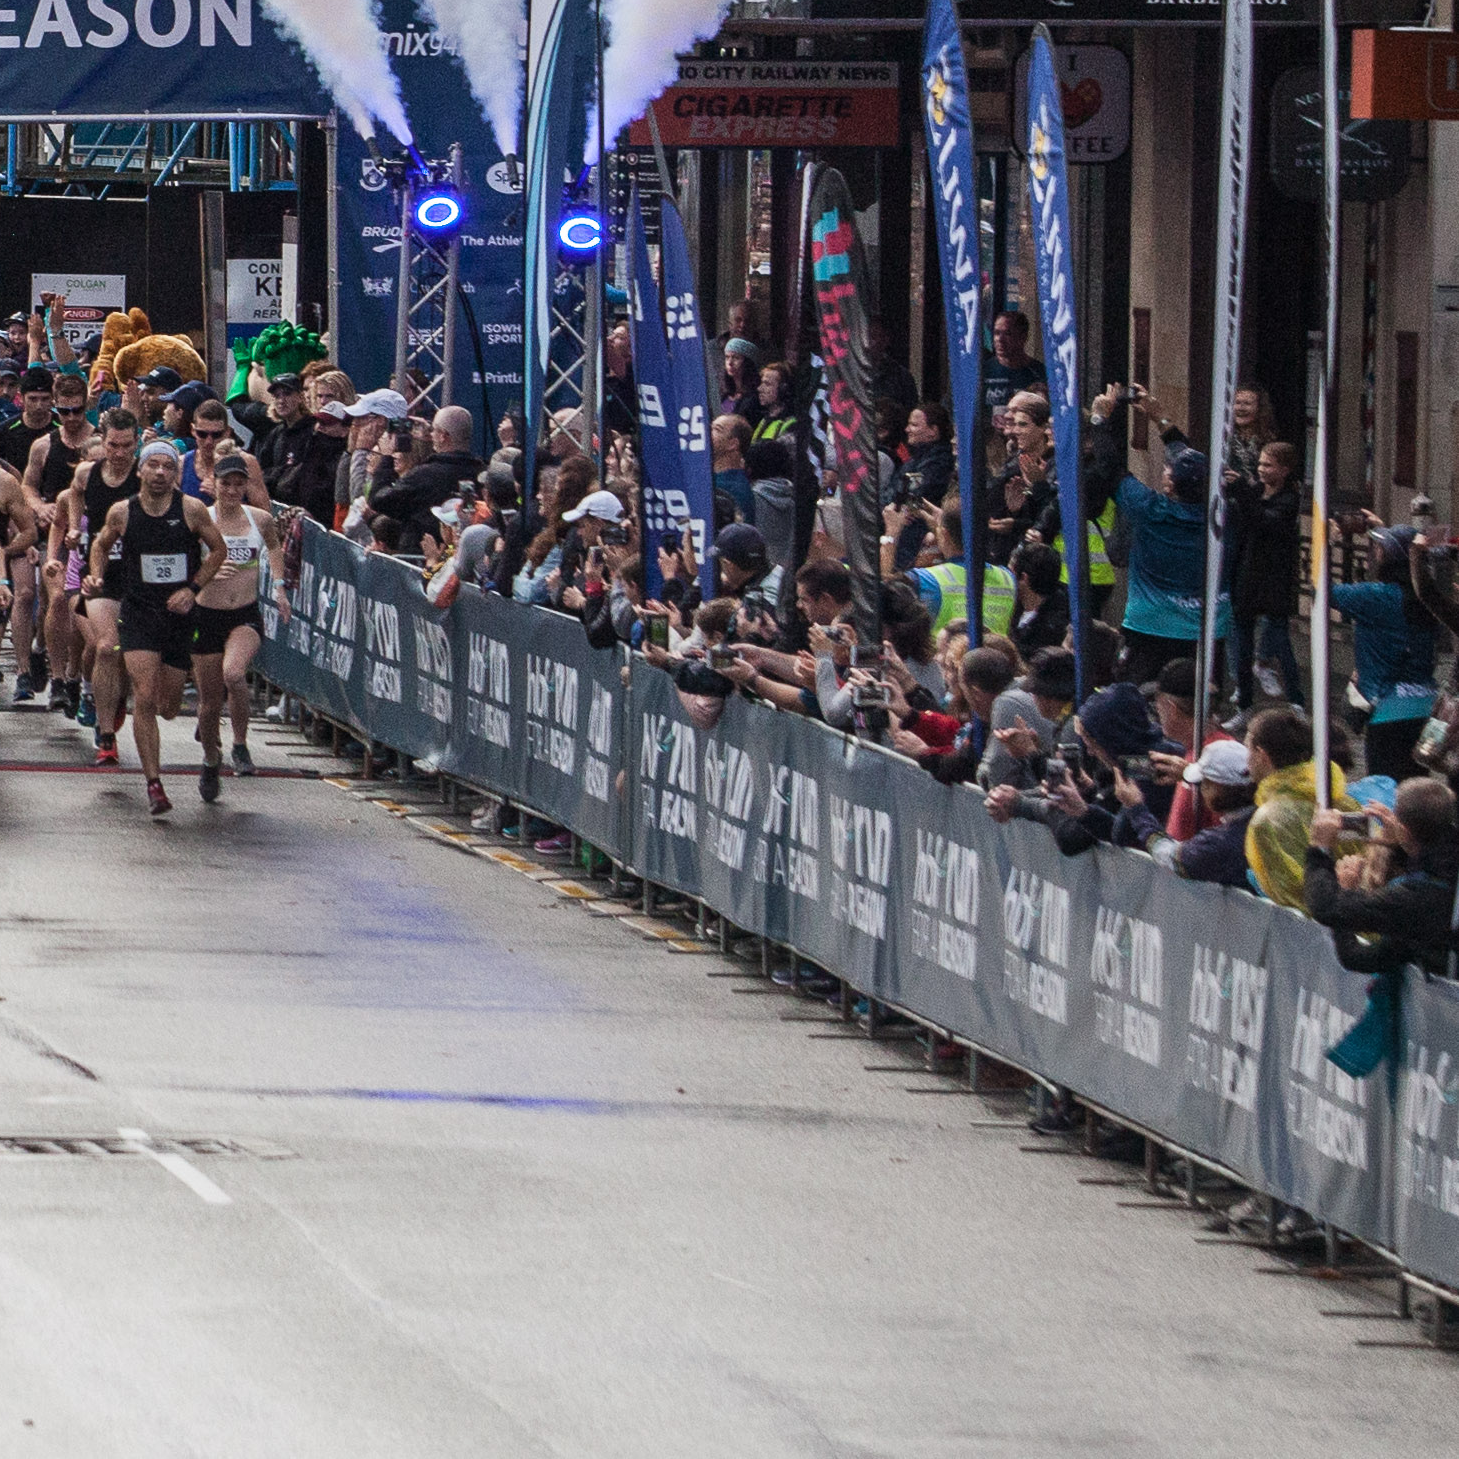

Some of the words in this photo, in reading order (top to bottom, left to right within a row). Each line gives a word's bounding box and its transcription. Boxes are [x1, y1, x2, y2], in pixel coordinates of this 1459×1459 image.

[702, 66, 745, 81] CITY
[751, 66, 830, 81] RAILWAY
[837, 66, 891, 82] NEWS
[673, 94, 853, 118] CIGARETTE
[688, 116, 838, 138] EXPRESS
[460, 235, 484, 246] The
[156, 566, 172, 579] 28
